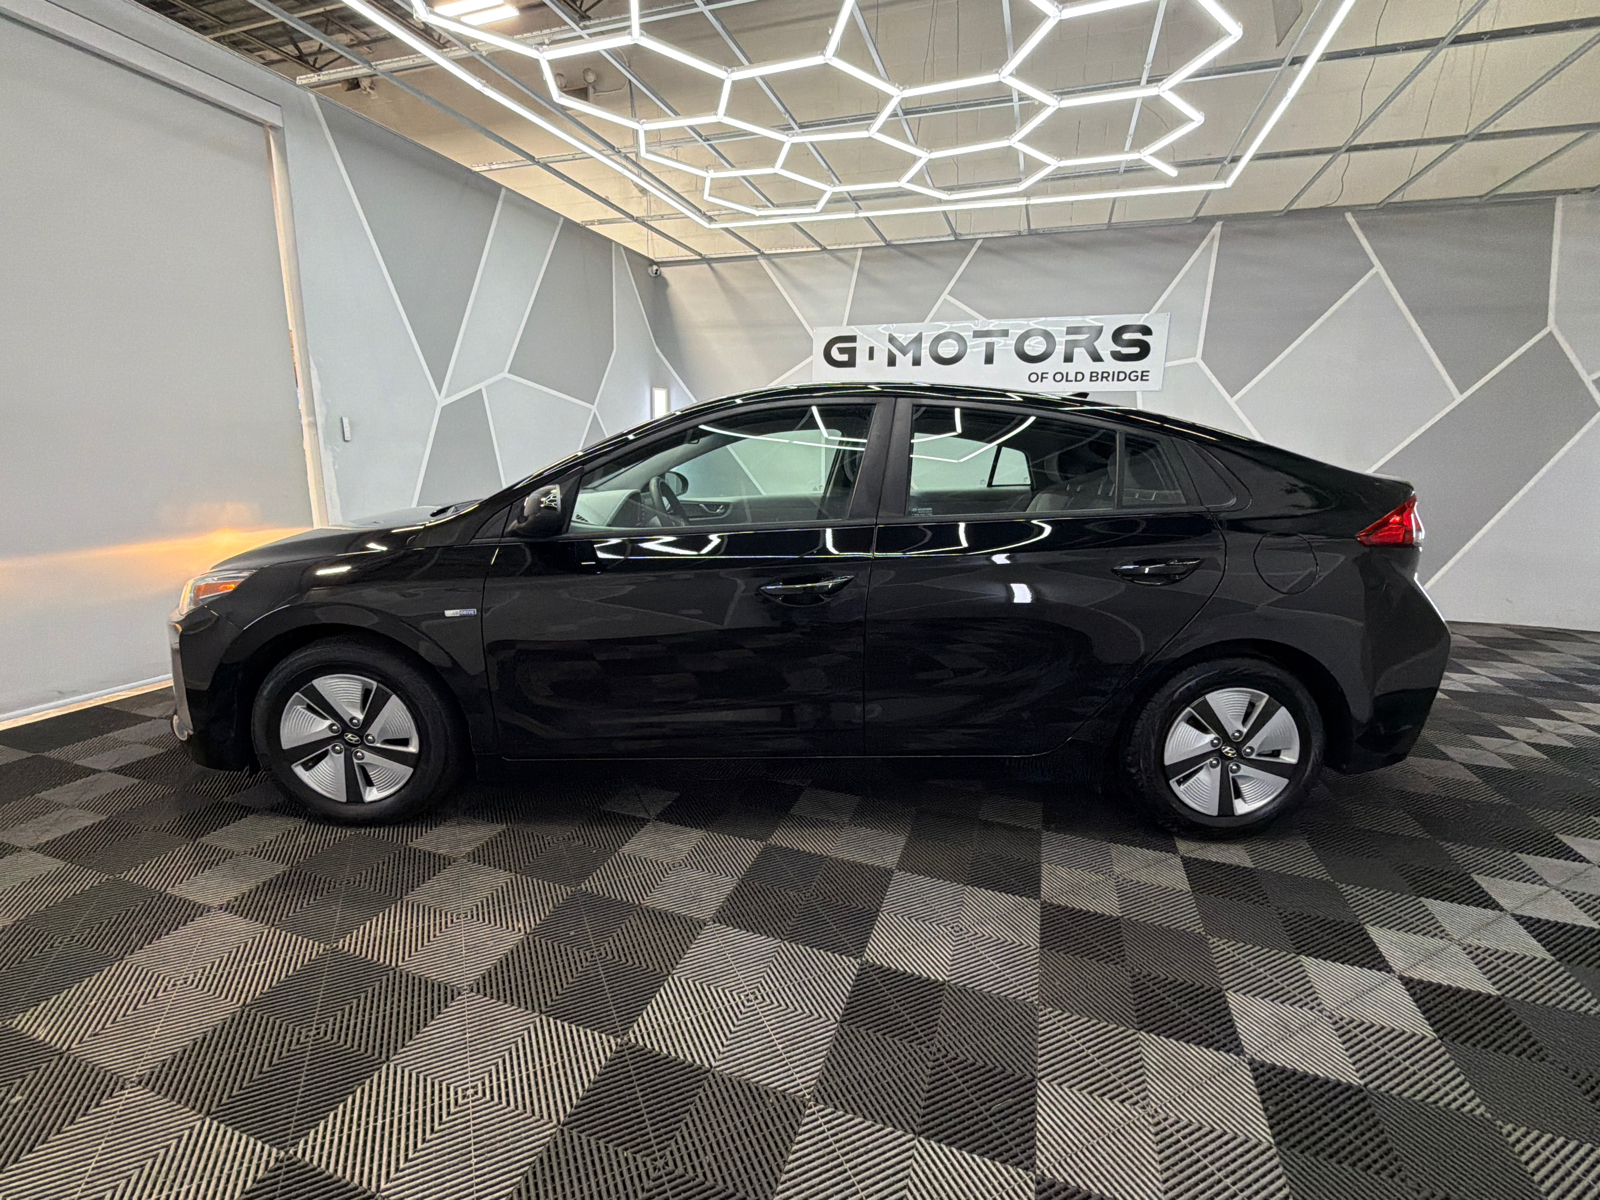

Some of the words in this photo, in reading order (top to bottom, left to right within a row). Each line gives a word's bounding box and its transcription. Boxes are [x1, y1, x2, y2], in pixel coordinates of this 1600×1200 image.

[887, 324, 1153, 367] MOTORS
[1028, 372, 1049, 383] OF
[1053, 371, 1085, 383] OLD
[1089, 370, 1150, 382] BRIDGE
